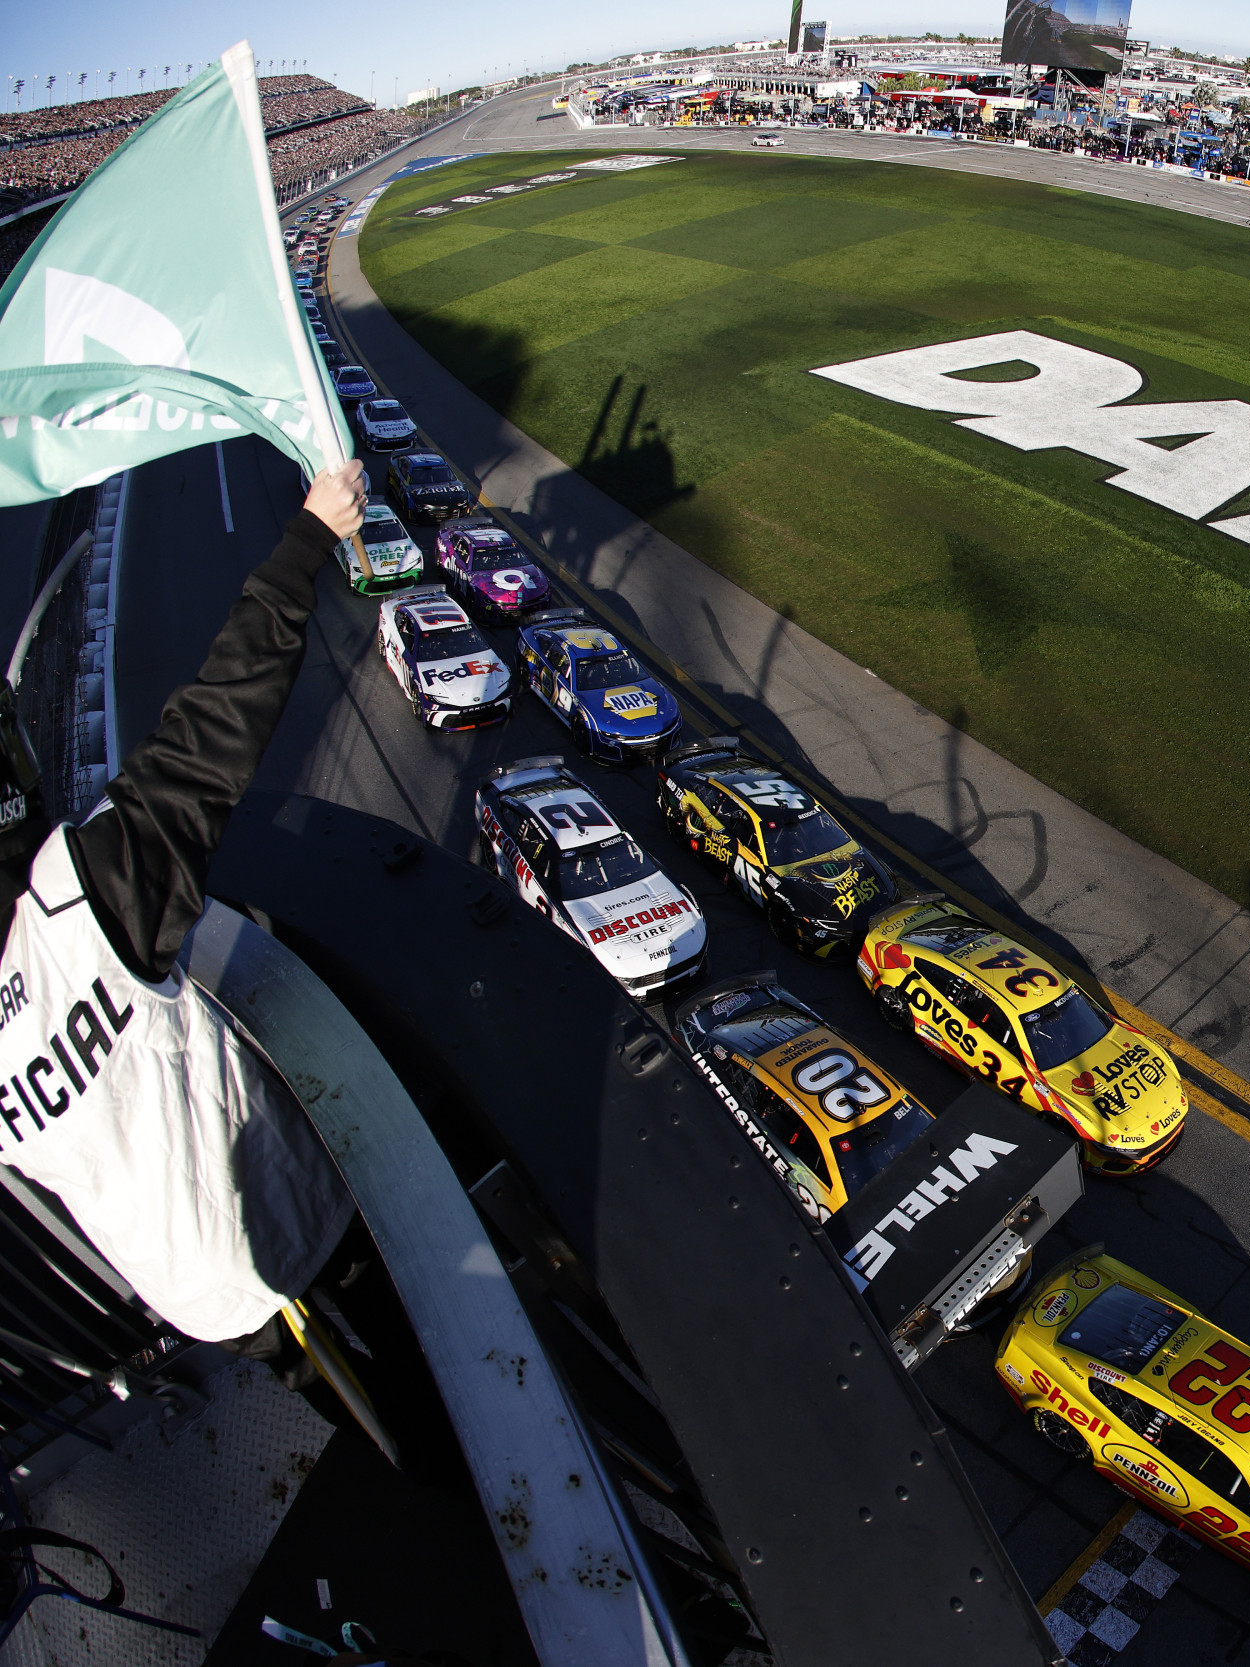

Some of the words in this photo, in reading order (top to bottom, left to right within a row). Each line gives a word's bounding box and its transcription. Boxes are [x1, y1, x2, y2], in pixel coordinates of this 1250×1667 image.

[378, 425, 410, 434] Health
[415, 484, 466, 497] ZEIGLER
[365, 545, 413, 557] DOLLAR
[370, 552, 405, 563] TREE
[451, 624, 473, 633] HAMLIN
[421, 660, 504, 687] FedEx
[609, 690, 653, 711] NAPA
[538, 801, 614, 829] 2
[482, 805, 535, 889] DISCOUNT
[599, 835, 625, 848] CINDRIC
[704, 836, 733, 865] BEAST
[604, 893, 650, 912] tires.com
[831, 875, 880, 920] BEAST
[588, 900, 692, 945] DISCOUNT
[633, 925, 668, 941] TIRE
[814, 930, 828, 939] 45
[648, 945, 678, 961] PENNZOIL
[975, 947, 1060, 998] 34
[0, 976, 135, 1150] FICIAL
[774, 1038, 830, 1068] GUARANTEED
[791, 1049, 892, 1123] 20
[975, 1050, 1029, 1103] 34
[691, 1052, 789, 1174] INTERSTATE
[893, 1103, 914, 1120] BELL
[1041, 1291, 1070, 1323] PENNZOIL
[1087, 1361, 1127, 1383] DISCOUNT
[1095, 1372, 1113, 1383] TIRE
[1030, 1369, 1112, 1439] Shell
[1177, 1414, 1197, 1429] JOEY
[1196, 1426, 1226, 1446] LOGANO
[1112, 1452, 1179, 1499] PENNZOIL
